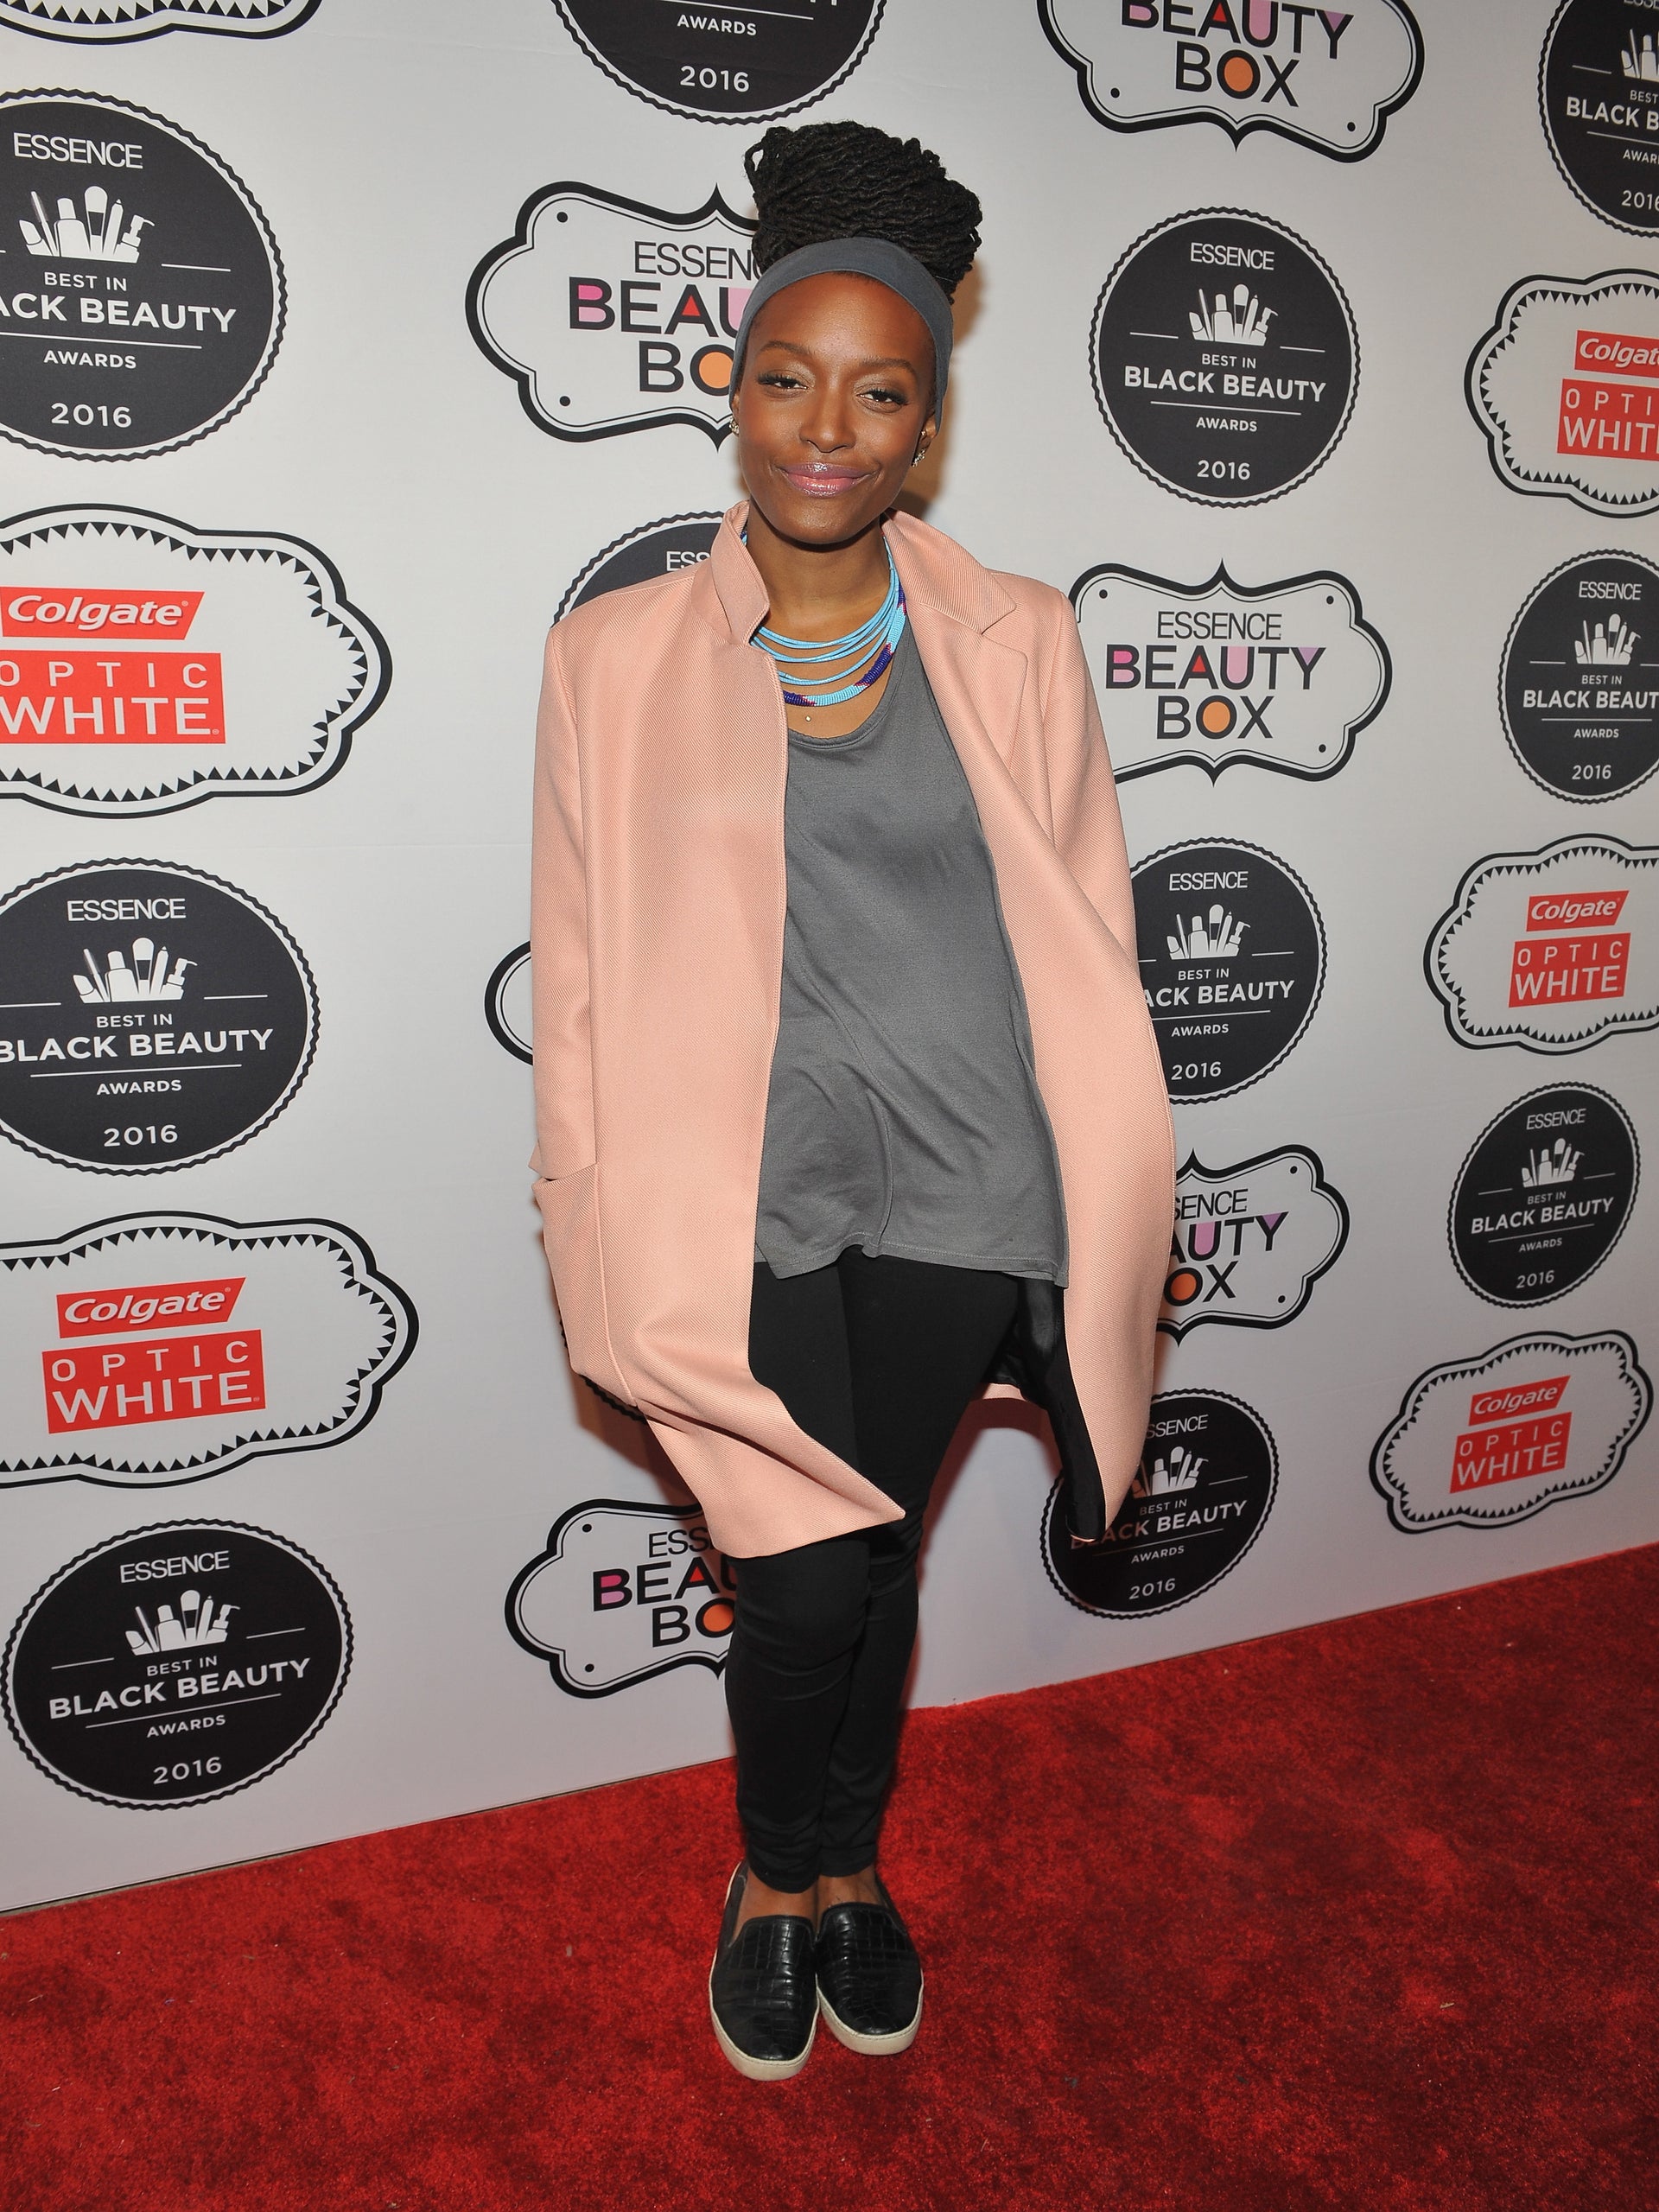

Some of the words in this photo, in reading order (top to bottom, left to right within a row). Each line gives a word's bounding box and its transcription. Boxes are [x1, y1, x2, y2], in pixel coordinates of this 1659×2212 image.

[677, 15, 757, 35] AWARDS
[1122, 0, 1354, 60] BEAUTY
[680, 66, 749, 92] 2016
[1176, 41, 1300, 107] BOX
[1630, 89, 1658, 105] BEST
[1567, 96, 1640, 128] BLACK
[13, 132, 143, 168] ESSENCE
[1623, 149, 1659, 164] AWAR
[634, 241, 761, 281] ESSEN
[1190, 242, 1275, 271] ESSENCE
[44, 272, 97, 289] BEST
[106, 277, 127, 291] IN
[80, 296, 237, 333] BEAUTY
[43, 350, 137, 369] AWARDS
[1202, 353, 1238, 368] BEST
[1242, 355, 1257, 369] IN
[1580, 338, 1659, 368] Colgat
[1124, 365, 1216, 394] BLACK
[1224, 372, 1326, 403] BEAUTY
[51, 403, 131, 428] 2016
[1195, 416, 1258, 432] AWARDS
[1563, 416, 1659, 454] WHIT
[1197, 459, 1250, 481] 2016
[1579, 581, 1642, 601] ESSENCE
[8, 594, 182, 630] Colgate
[1157, 611, 1282, 640] ESSENCE
[0, 661, 207, 689] OPTIC
[1106, 644, 1326, 690] BEAUTY
[1581, 675, 1608, 684] BEST
[1611, 676, 1622, 684] IN
[1523, 690, 1590, 709] BLACK
[0, 696, 211, 735] WHITE
[1156, 695, 1274, 740] BOX
[1574, 728, 1619, 738] AWARDS
[1572, 764, 1611, 780] 2016
[1168, 870, 1249, 891] ESSENCE
[67, 898, 186, 921] ESSENCE
[1530, 898, 1618, 924] Colgate
[1516, 940, 1623, 967] OPTIC
[1178, 969, 1211, 981] BEST
[1216, 969, 1230, 978] IN
[1515, 965, 1619, 1001] WHITE
[1198, 980, 1295, 1004] BEAUTY
[96, 1014, 145, 1028] BEST
[153, 1014, 173, 1026] IN
[1172, 1024, 1229, 1037] AWARDS
[0, 1035, 118, 1063] BLACK
[130, 1028, 273, 1056] BEAUTY
[1171, 1061, 1222, 1080] 2016
[97, 1079, 182, 1096] AWARDS
[1526, 1109, 1586, 1131] ESSENCE
[104, 1124, 178, 1147] 2016
[1527, 1192, 1554, 1205] BEST
[1555, 1192, 1566, 1201] IN
[1471, 1211, 1535, 1235] BLACK
[1540, 1197, 1614, 1225] BEAUTY
[1519, 1237, 1562, 1253] AWARDS
[1516, 1270, 1555, 1288] 2016
[64, 1290, 226, 1325] Colgate
[52, 1340, 250, 1382] OPTIC
[53, 1370, 255, 1423] WHITE
[1473, 1387, 1559, 1416] Colgate
[1459, 1421, 1563, 1457] OPTIC
[1456, 1441, 1561, 1486] WHITE
[1140, 1501, 1171, 1516] BEST
[1175, 1498, 1187, 1509] IN
[1157, 1500, 1247, 1533] BEAUTY
[1131, 1545, 1185, 1563] AWARDS
[119, 1551, 231, 1584] ESSENCE
[1129, 1578, 1176, 1599] 2016
[147, 1659, 194, 1677] BEST
[199, 1655, 218, 1668] IN
[48, 1682, 167, 1720] BLACK
[176, 1657, 312, 1700] BEAUTY
[146, 1714, 226, 1738] AWARDS
[152, 1756, 223, 1785] 2016
